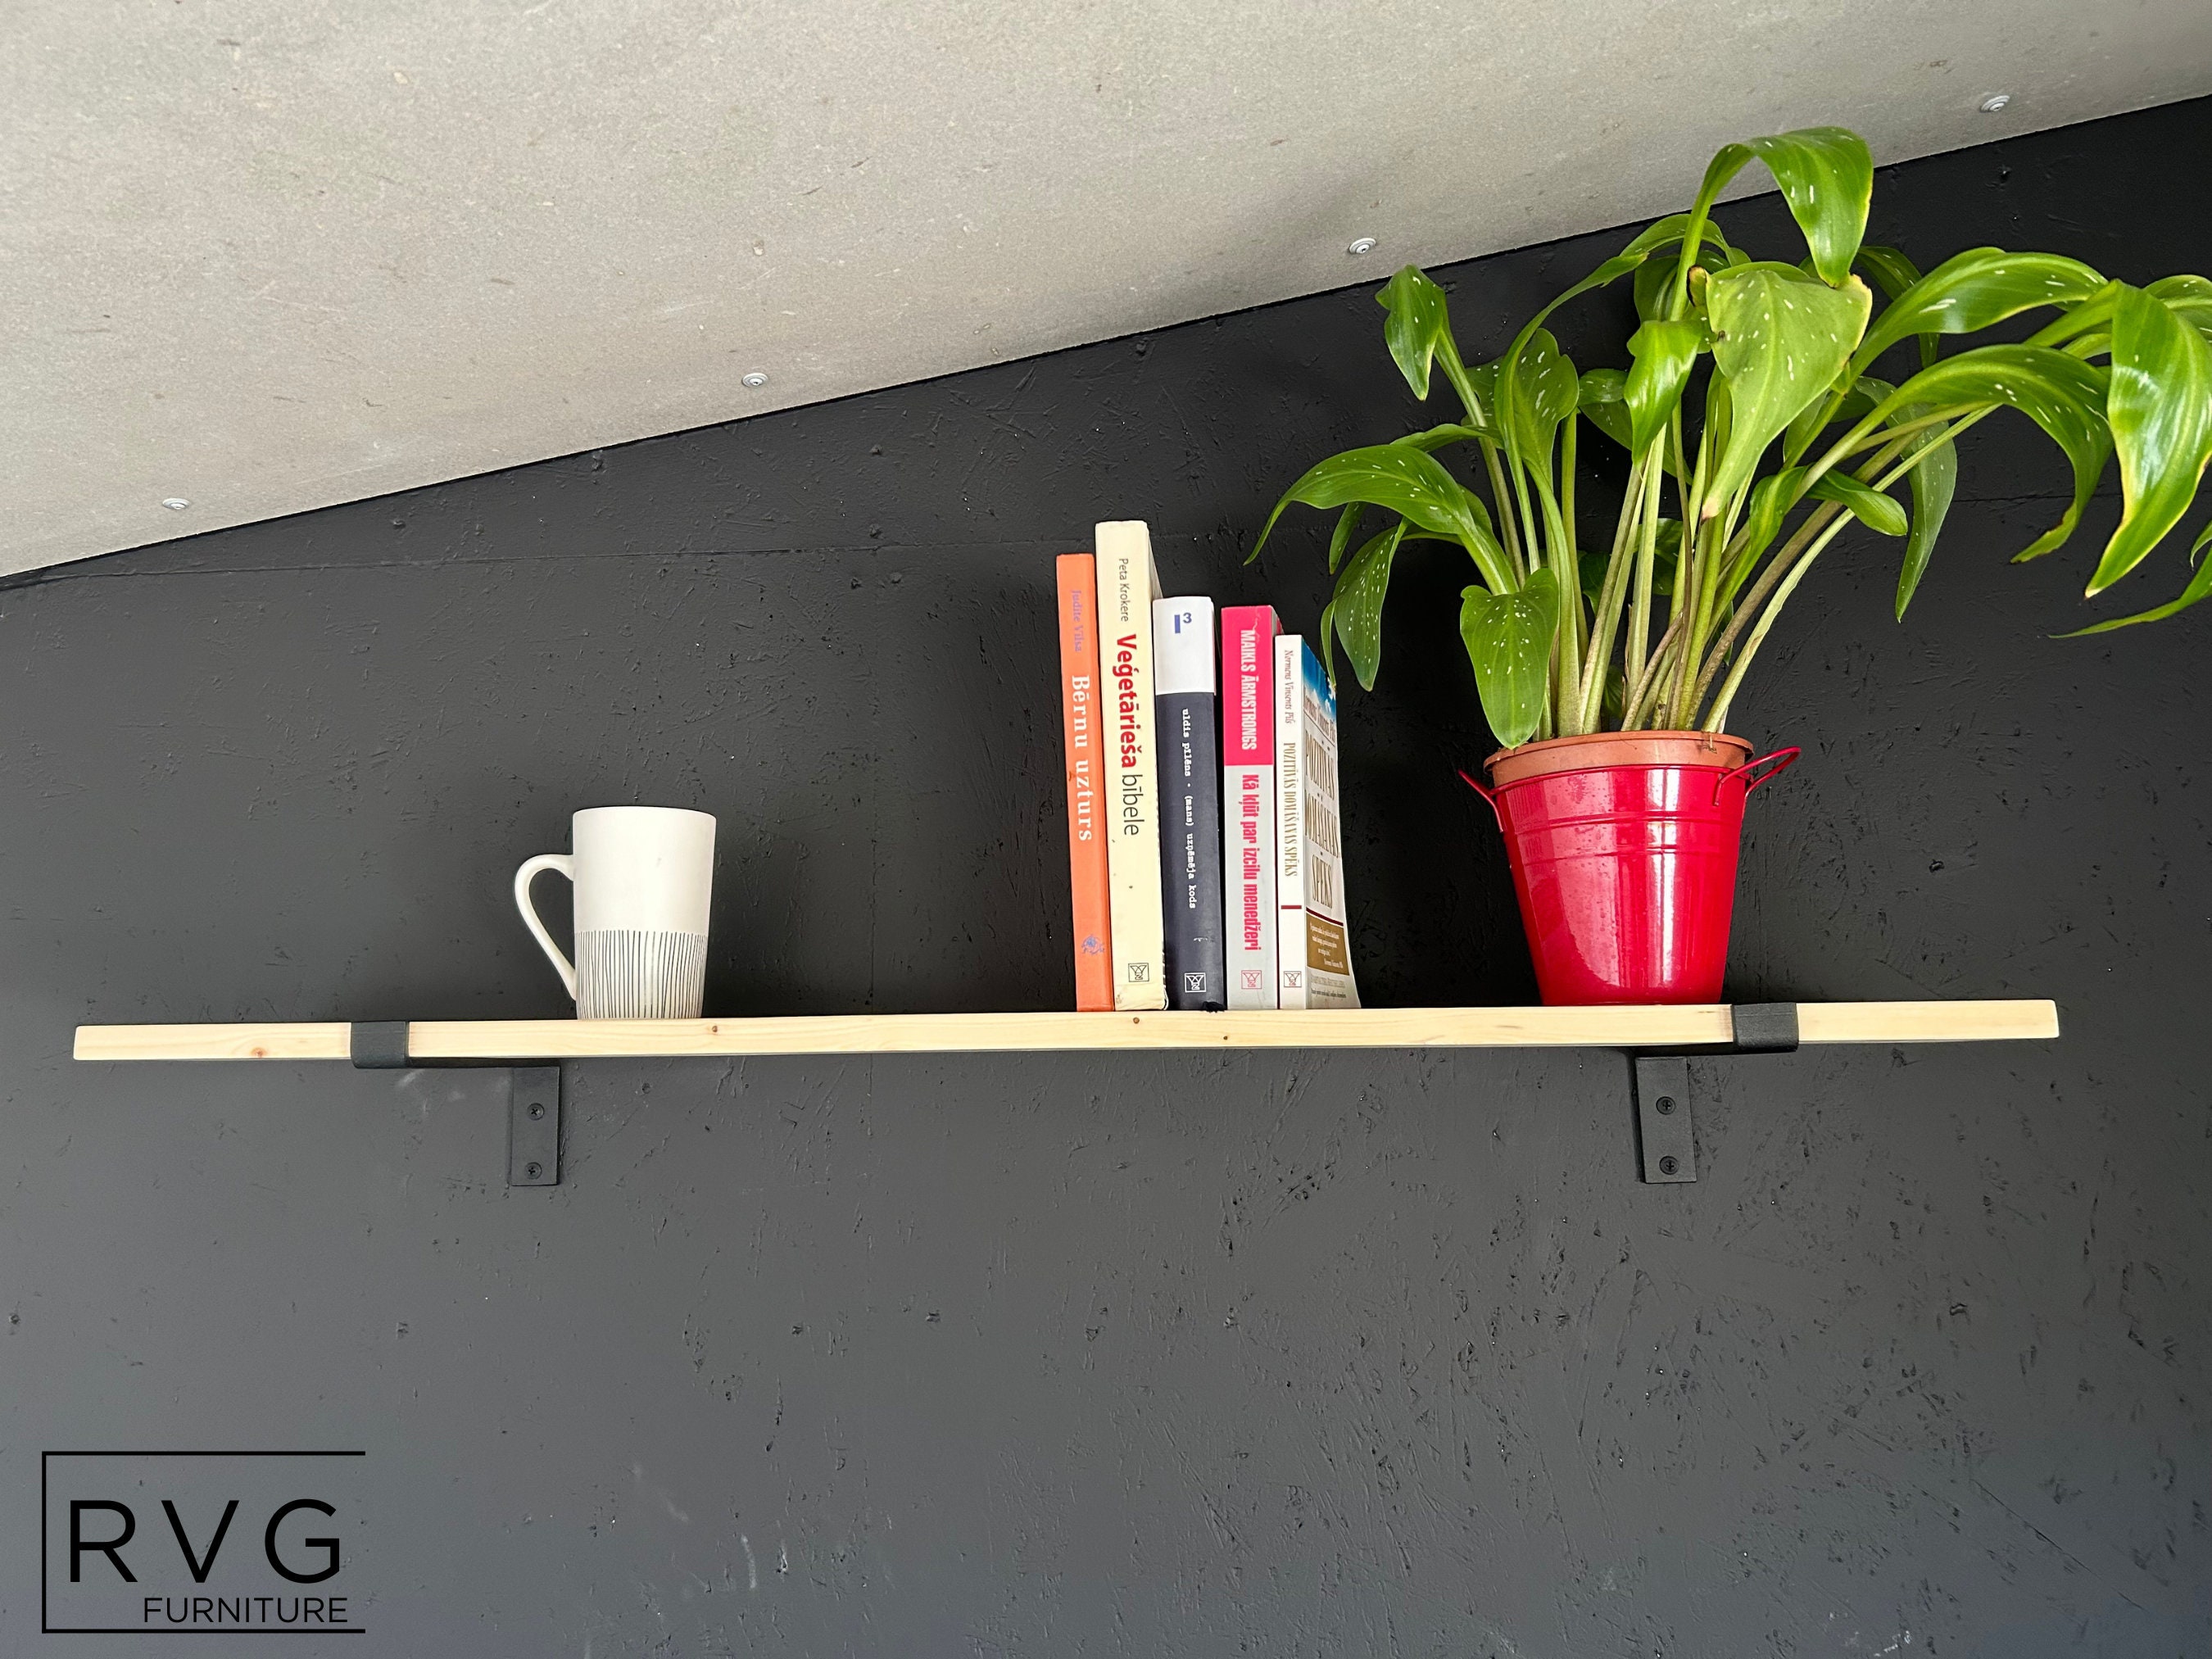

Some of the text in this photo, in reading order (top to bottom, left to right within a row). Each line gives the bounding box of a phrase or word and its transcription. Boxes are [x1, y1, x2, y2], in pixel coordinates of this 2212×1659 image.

[1072, 590, 1083, 621] Judite
[1119, 558, 1131, 622] Peta Krokere
[1241, 630, 1259, 750] MAIKLS ĀRMSTRONGS
[1113, 634, 1145, 836] Veģetārieša bībele
[1182, 708, 1191, 737] uldis
[1072, 675, 1094, 841] Bērnu uzturs
[1184, 796, 1194, 827] (mans)
[1239, 774, 1262, 950] Kā kļūt par izcilu menedžeri
[1285, 846, 1299, 877] SPĒKS
[1188, 884, 1197, 909] kods
